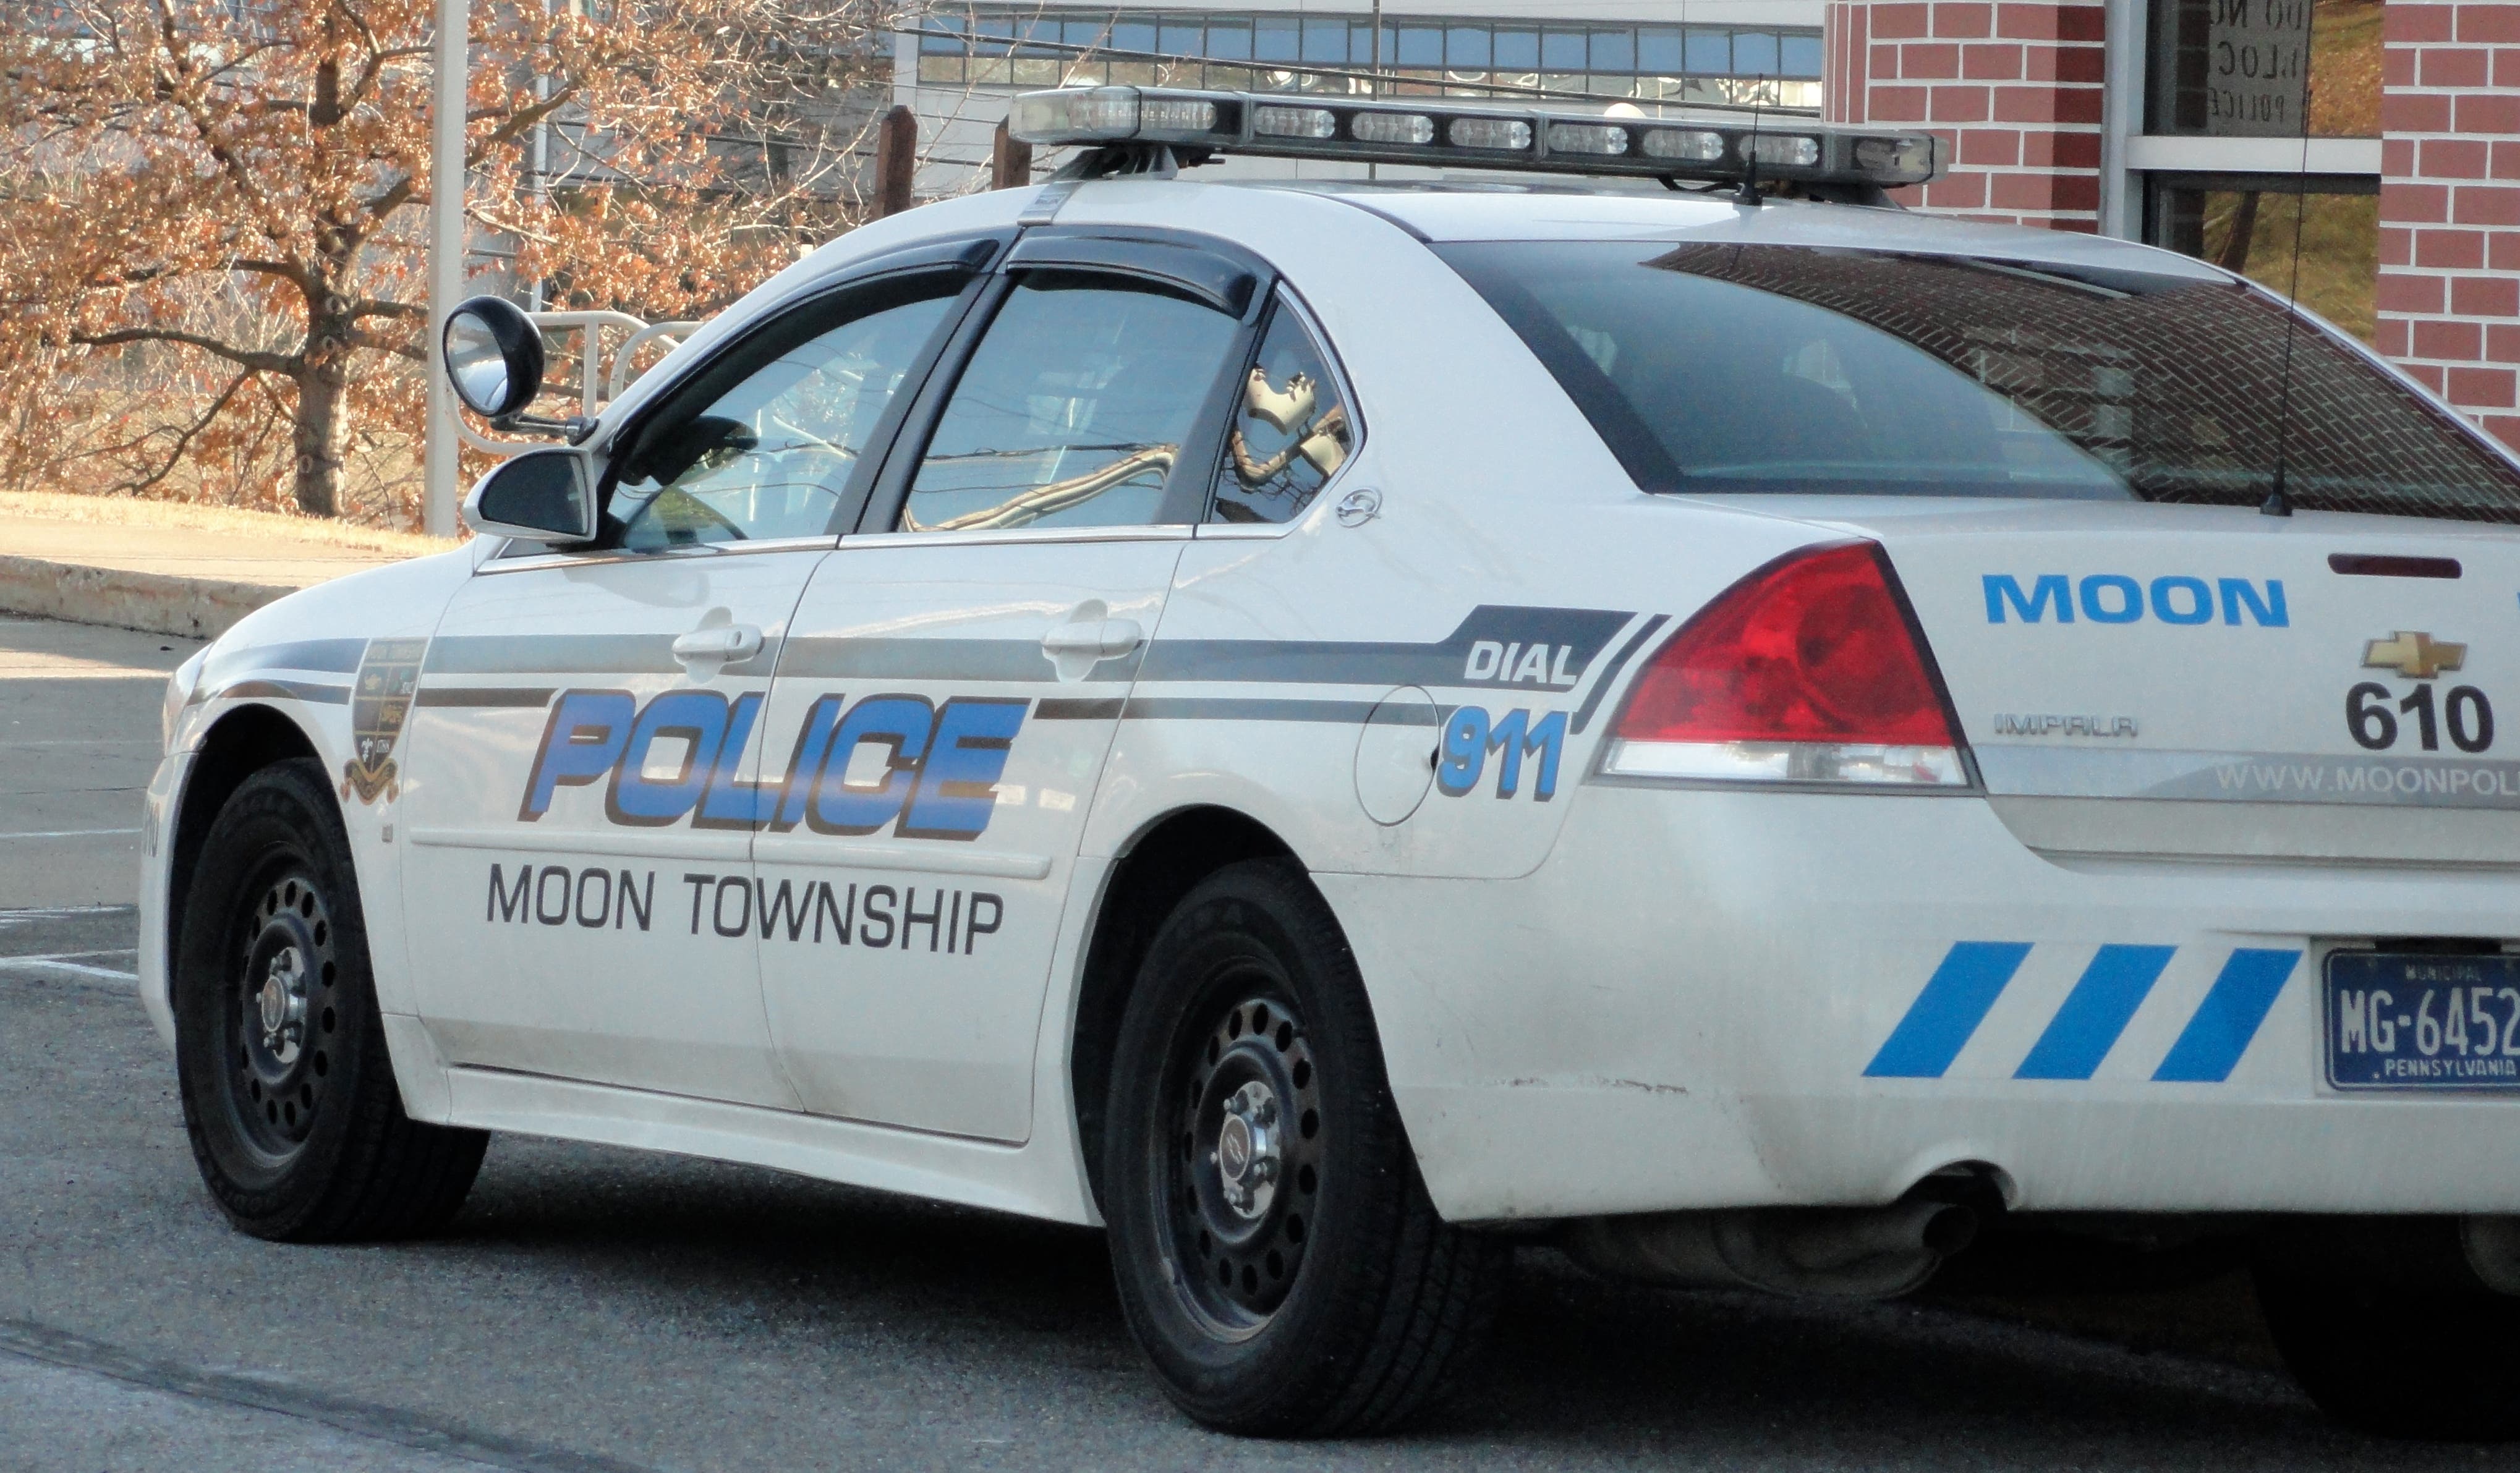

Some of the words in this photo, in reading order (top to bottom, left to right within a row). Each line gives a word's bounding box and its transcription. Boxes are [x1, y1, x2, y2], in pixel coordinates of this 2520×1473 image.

[1982, 574, 2290, 628] MOON
[1463, 640, 1581, 685] DIAL
[1994, 713, 2139, 737] IMPALA
[2346, 682, 2495, 753] 610
[517, 688, 1031, 841] POLICE
[1436, 705, 1569, 802] 911
[487, 863, 655, 932] MOON
[683, 873, 1003, 956] TOWNSHIP
[2341, 987, 2520, 1056] MG-6452
[2385, 1058, 2517, 1077] PENNSYLVANIA
